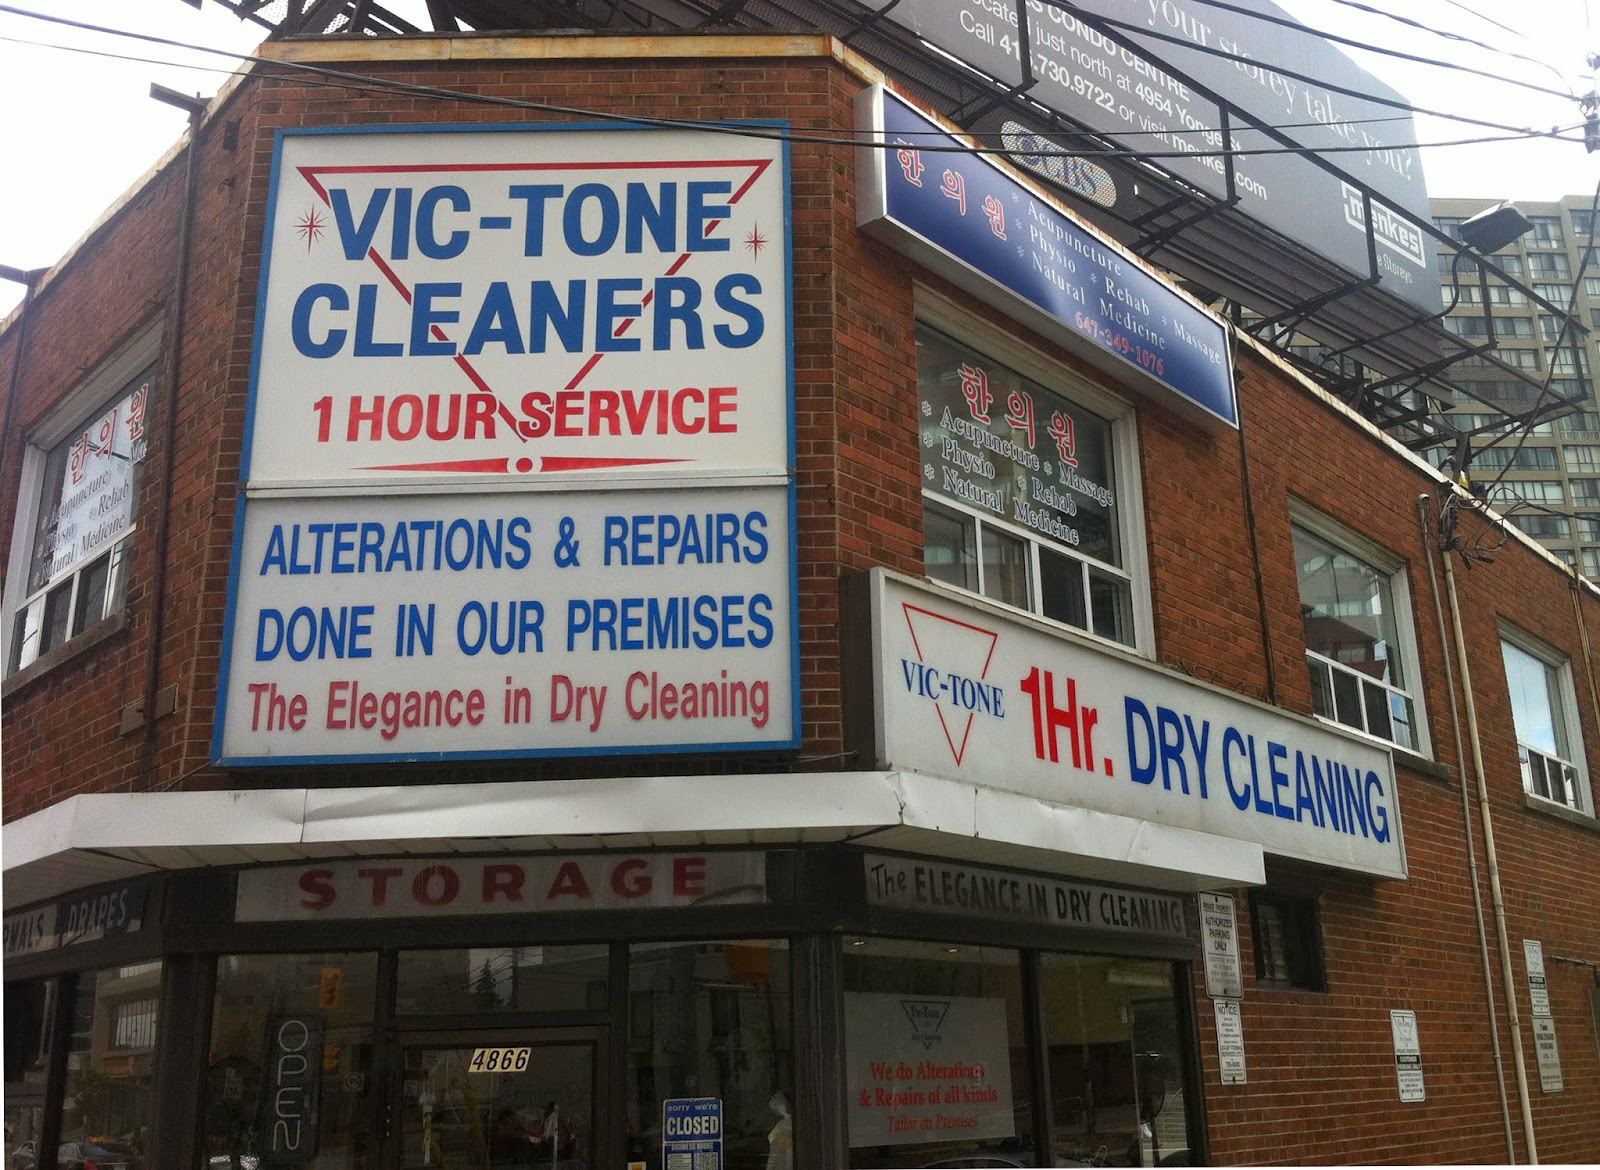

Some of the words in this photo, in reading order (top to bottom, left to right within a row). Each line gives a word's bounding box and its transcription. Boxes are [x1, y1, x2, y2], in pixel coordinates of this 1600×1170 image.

[1036, 21, 1066, 56] just
[1071, 46, 1112, 82] north
[1117, 74, 1132, 93] at
[1135, 82, 1174, 117] 4954
[1175, 103, 1223, 146] Yonge
[1048, 5, 1116, 56] CONDO
[1121, 47, 1190, 102] CENTRE
[961, 10, 995, 46] Call
[1000, 34, 1115, 114] 41.730.9722
[1119, 105, 1135, 123] or
[1139, 115, 1169, 143] visit
[1172, 134, 1267, 200] menke.com
[1148, 0, 1211, 46] your
[1219, 36, 1296, 114] storey
[1303, 88, 1356, 143] take
[1360, 130, 1411, 180] you?
[329, 181, 732, 261] VIC-TONE
[894, 138, 1007, 240] 한의원
[1028, 201, 1121, 276] Acupuncture
[291, 273, 765, 359] CLEANERS
[1029, 224, 1076, 273] Physio
[1105, 276, 1150, 316] Rehab
[1173, 319, 1221, 364] Massage
[1032, 251, 1085, 305] Natural
[1100, 297, 1165, 350] Medicine
[1075, 311, 1164, 376] 647-349-1076
[313, 396, 334, 443] 1
[346, 392, 497, 443] HOUR
[516, 386, 738, 439] SERVICE
[957, 363, 1078, 468] 한의원
[940, 405, 1040, 471] Acupuncture
[1058, 461, 1113, 507] Massage
[941, 435, 995, 480] Physio
[1031, 476, 1077, 516] Rehab
[50, 470, 110, 522] Acupuncture
[98, 479, 129, 516] Rehab
[942, 465, 1005, 514] Natural
[1013, 497, 1079, 546] Medicine
[80, 514, 125, 555] Medicine
[259, 516, 532, 576] ALTERATIONS
[553, 516, 581, 568] &
[603, 511, 769, 567] REPAIRS
[255, 605, 375, 662] DONE
[395, 603, 435, 658] IN
[456, 600, 544, 656] OUR
[567, 593, 774, 651] PREMISES
[247, 683, 308, 732] The
[326, 680, 485, 740] Elegance
[504, 677, 532, 725] in
[550, 674, 608, 732] Dry
[625, 670, 770, 729] Cleaning
[901, 658, 1005, 719] VIC-TONE
[1020, 666, 1113, 777] 1Hr.
[1124, 695, 1210, 799] DRY
[1222, 726, 1391, 844] CLEANING
[68, 887, 130, 933] DRAPES
[299, 857, 706, 911] STORAGE
[870, 863, 907, 899] The
[913, 866, 1021, 914] ELEGANCE
[1028, 882, 1049, 916] IN
[1055, 886, 1093, 923] DRY
[1100, 892, 1182, 932] CLEANING
[1205, 916, 1232, 928] AUTHORIZED
[1209, 928, 1230, 940] PARKING
[1214, 941, 1227, 951] ONLY
[273, 1019, 309, 1151] OPEN
[472, 1048, 530, 1072] 4866
[870, 1062, 893, 1080] We
[896, 1061, 913, 1080] do
[917, 1060, 985, 1080] Alterations
[667, 1104, 690, 1112] sorry
[694, 1102, 718, 1111] we're
[667, 1115, 719, 1136] CLOSED
[860, 1088, 871, 1107] &
[875, 1086, 926, 1112] Repairs
[928, 1086, 941, 1105] of
[944, 1085, 960, 1104] all
[963, 1085, 998, 1103] kinds
